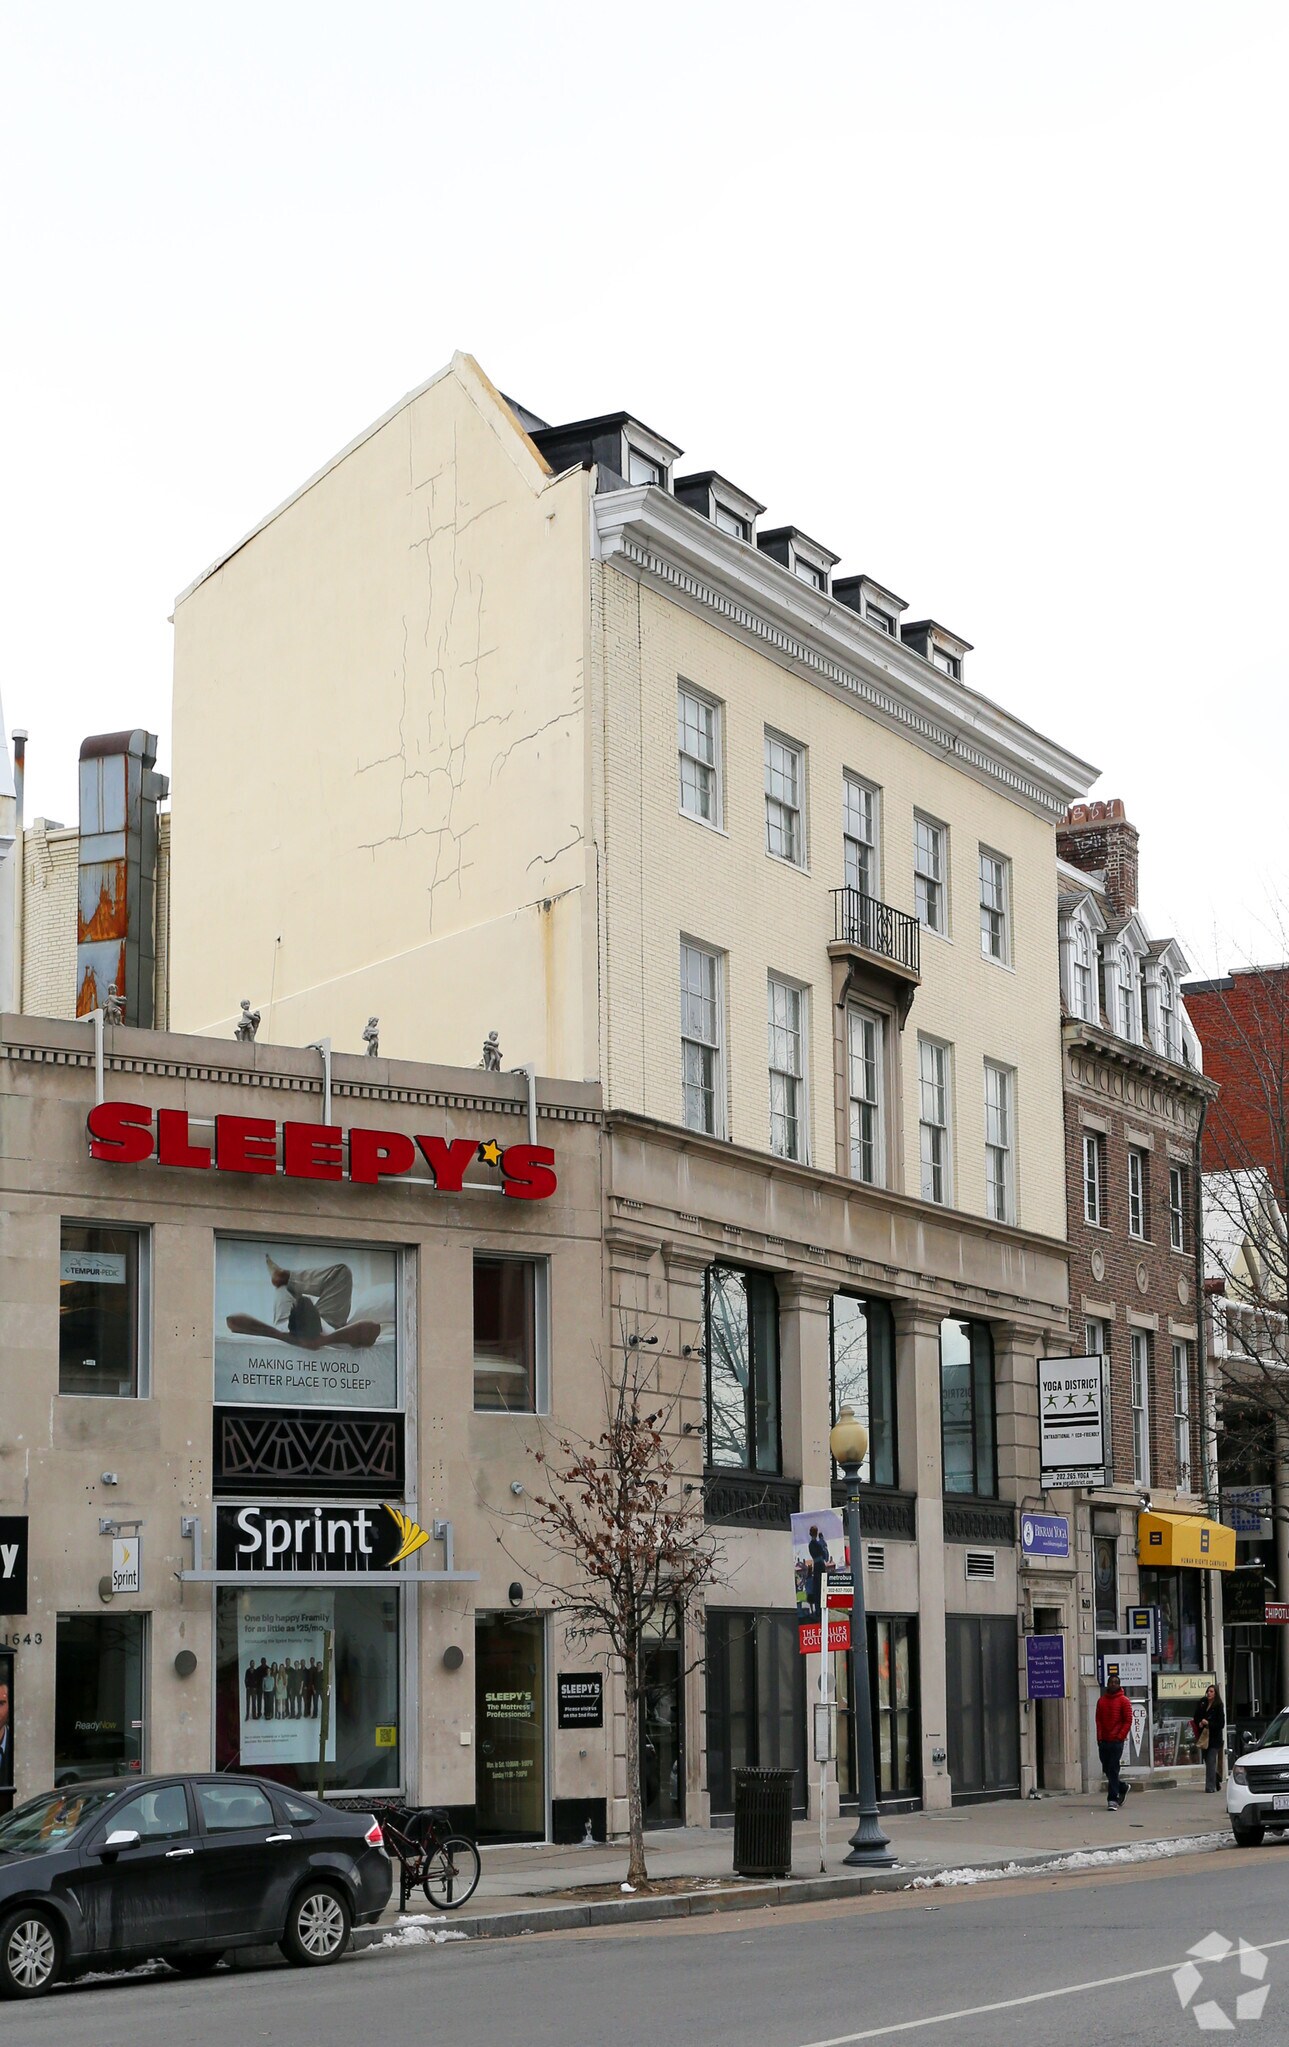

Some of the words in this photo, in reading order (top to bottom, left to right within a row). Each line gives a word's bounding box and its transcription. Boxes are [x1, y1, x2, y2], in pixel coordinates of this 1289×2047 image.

[71, 1267, 119, 1276] TEMPUR-PEDIC
[248, 1358, 294, 1371] MAKING
[297, 1360, 317, 1371] THE
[320, 1362, 360, 1374] WORLD
[231, 1373, 240, 1384] A
[243, 1374, 283, 1386] BETTER
[286, 1376, 319, 1388] PLACE
[322, 1377, 338, 1389] TO
[1042, 1381, 1062, 1392] YOGA
[1065, 1378, 1098, 1391] DISTRICT
[1056, 1472, 1089, 1480] 202.265.YOGA
[237, 1507, 373, 1567] Sprint
[113, 1570, 137, 1590] Sprint
[244, 1614, 261, 1622] One
[262, 1614, 274, 1624] big
[275, 1614, 300, 1623] happy
[245, 1625, 256, 1633] for
[267, 1625, 286, 1633] little
[802, 1628, 815, 1638] THE
[818, 1625, 847, 1637] PLLIPS
[4, 1633, 43, 1645] 1643
[802, 1635, 847, 1646] COLLTION
[561, 1682, 600, 1695] SLEEPY'S
[485, 1691, 532, 1702] SLEEPY'S
